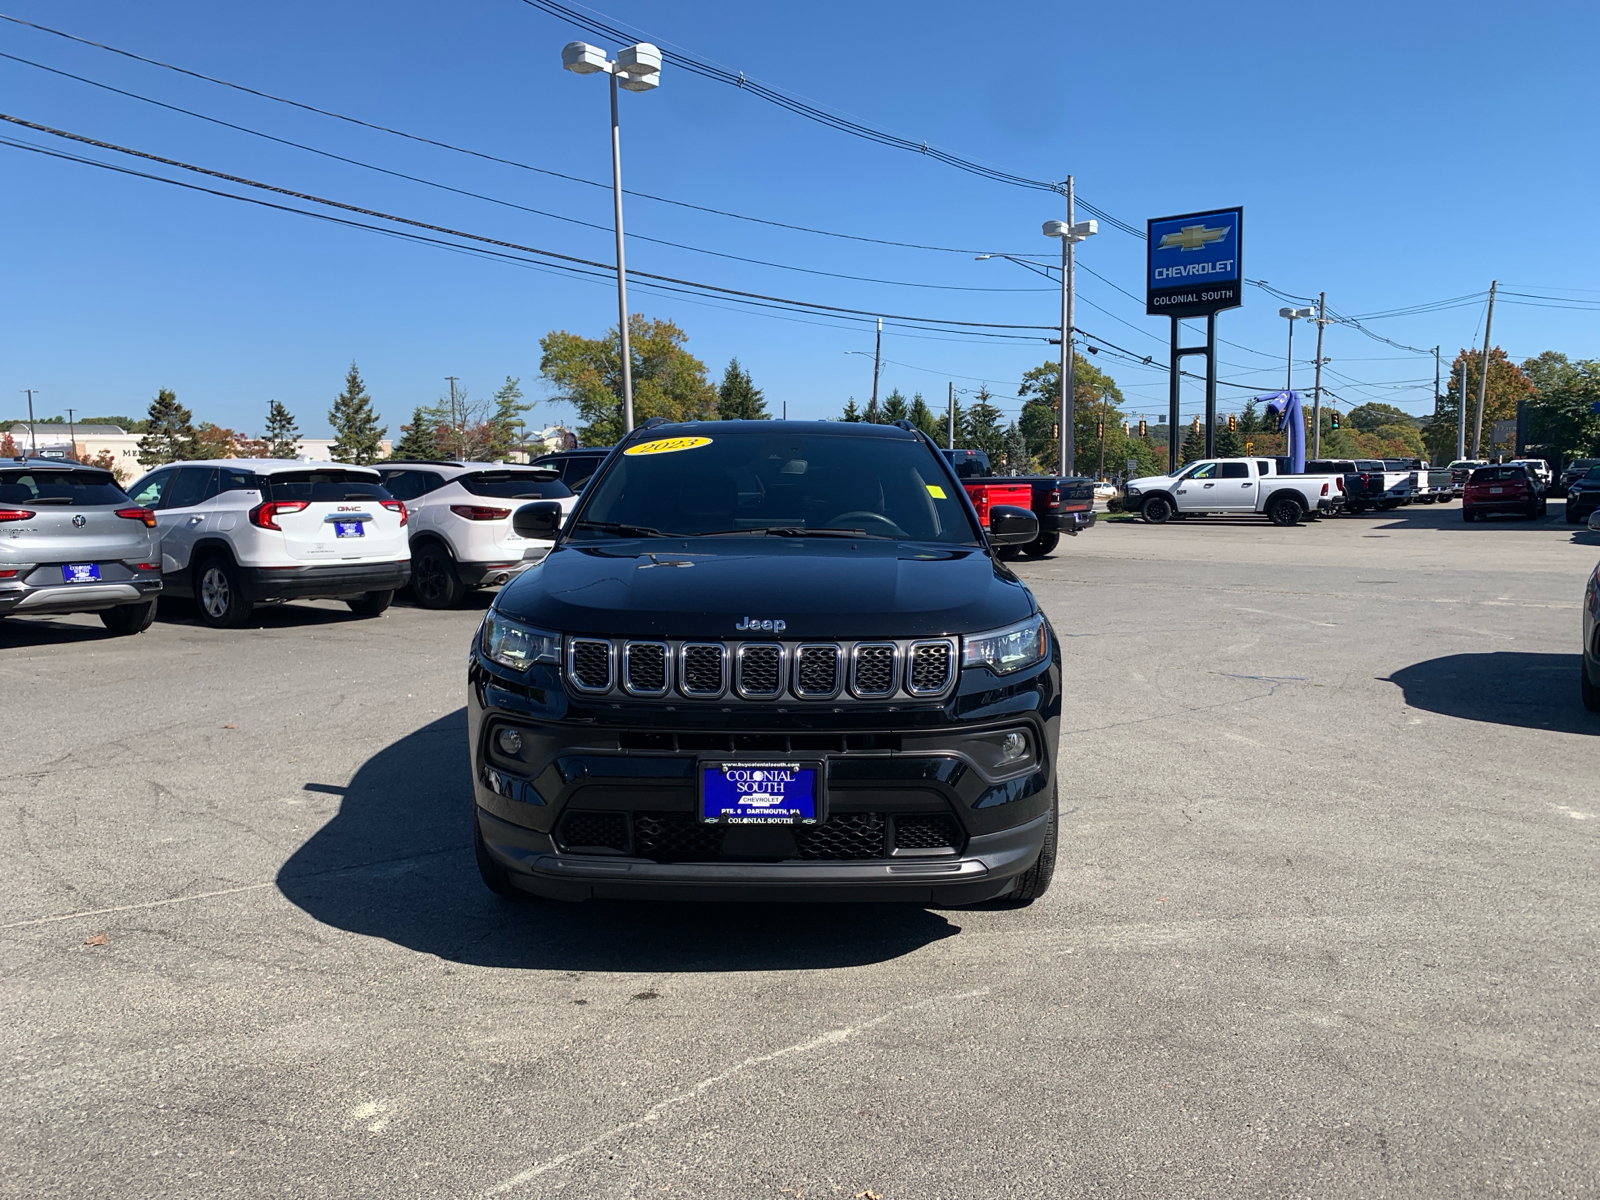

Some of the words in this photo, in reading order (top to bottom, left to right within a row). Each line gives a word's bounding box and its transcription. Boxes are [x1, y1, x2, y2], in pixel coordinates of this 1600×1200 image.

[1155, 260, 1233, 279] CHEVROLET
[1154, 294, 1198, 306] COLONIAL
[1201, 290, 1233, 301] SOUTH
[638, 439, 698, 453] 2023
[735, 616, 786, 634] Jeep
[726, 770, 796, 782] COLONIAL
[736, 782, 785, 793] SOUTH
[746, 808, 789, 816] DARTMOUTH,
